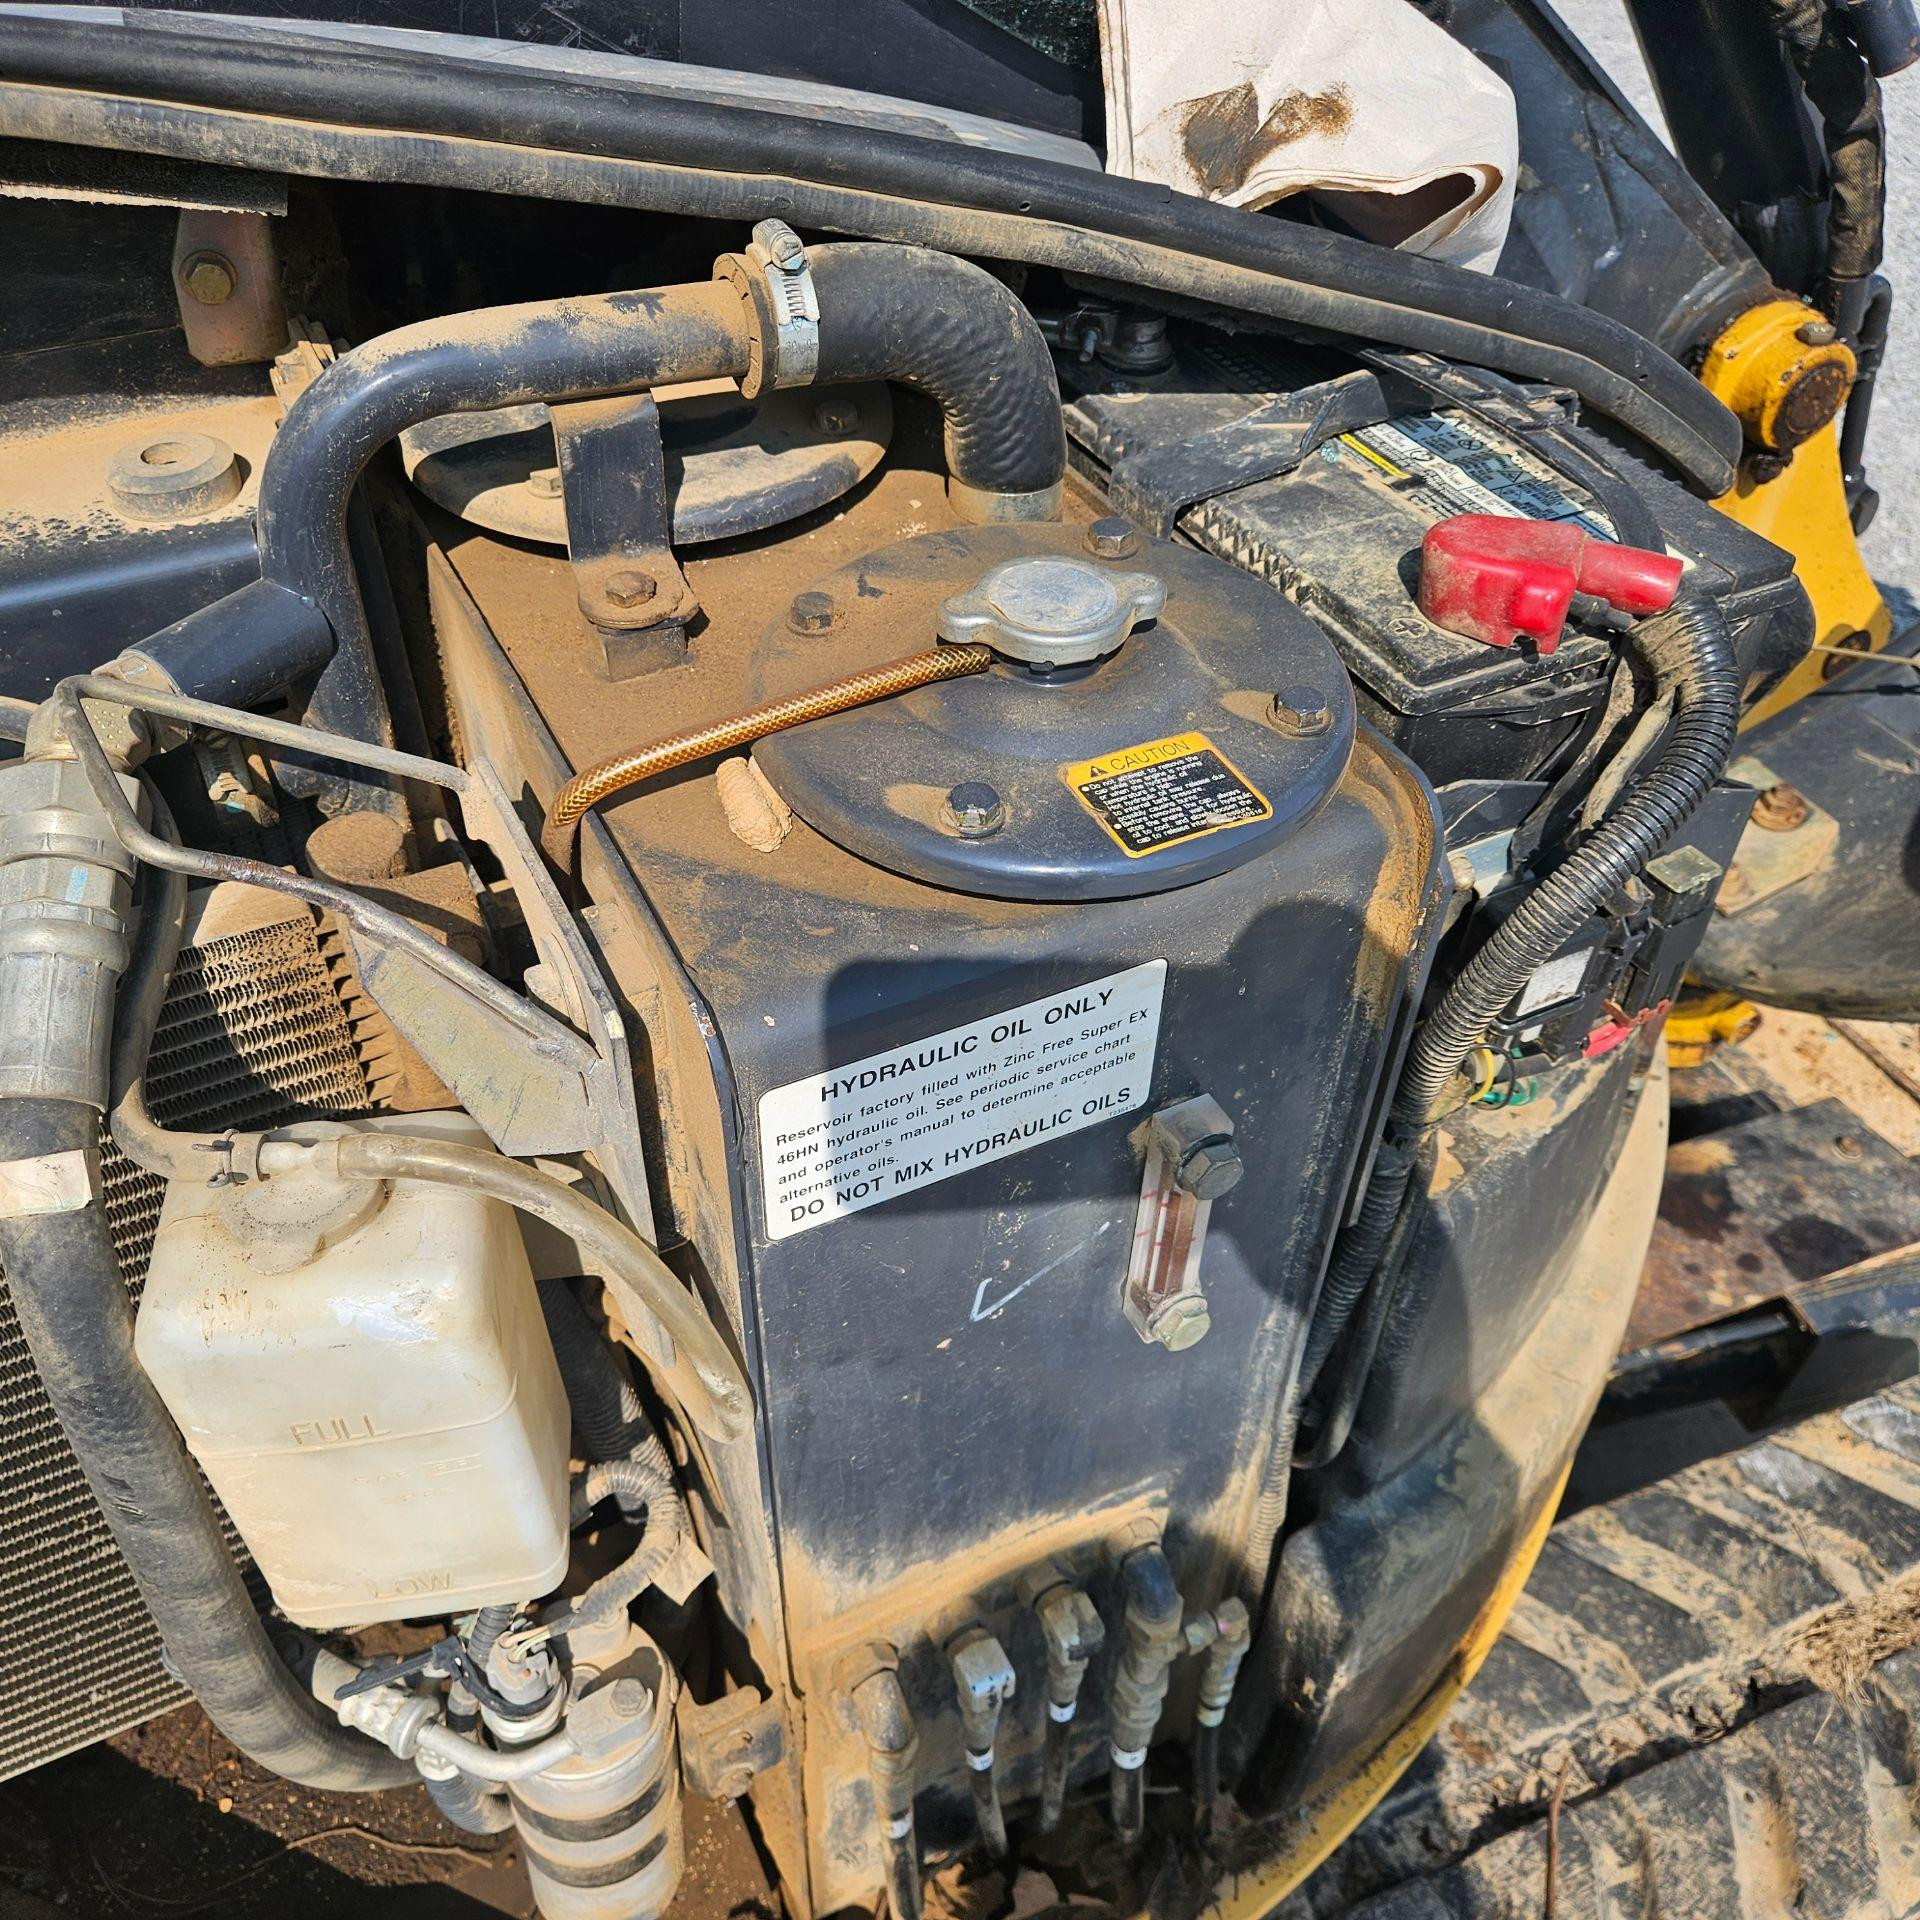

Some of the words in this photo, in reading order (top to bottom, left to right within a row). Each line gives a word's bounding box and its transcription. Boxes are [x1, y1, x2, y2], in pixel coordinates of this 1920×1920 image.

[1109, 740, 1190, 770] CAUTION
[776, 1112, 853, 1146] Reservoir
[860, 1092, 914, 1117] factory
[922, 1075, 958, 1096] filled
[966, 1063, 996, 1080] with
[1004, 1051, 1035, 1068] Zinc
[1043, 1037, 1074, 1054] Free
[1081, 1020, 1122, 1040] Super
[1129, 1008, 1148, 1023] EX
[777, 1143, 818, 1164] 46HN
[827, 1117, 898, 1148] hydraulic
[906, 1106, 928, 1120] oil.
[936, 1095, 963, 1110] See
[970, 1071, 1029, 1101] periodic
[1037, 1051, 1088, 1075] service
[1095, 1034, 1130, 1054] chart
[822, 1036, 978, 1102] HYDRAULIC
[991, 1019, 1032, 1043] OIL
[1045, 988, 1113, 1024] ONLY
[779, 1166, 806, 1185] and
[815, 1138, 892, 1171] operator's
[900, 1114, 954, 1142] manual
[961, 1109, 975, 1120] to
[982, 1082, 1054, 1112] determine
[1061, 1052, 1136, 1085] acceptable
[791, 1199, 824, 1222] DO
[837, 1176, 884, 1205] NOT
[895, 1158, 933, 1184] MIX
[945, 1109, 1072, 1166] HYDRAULIC
[1082, 1088, 1130, 1115] OILS
[780, 1169, 861, 1203] alternative
[868, 1157, 899, 1171] oils.
[290, 1414, 391, 1445] FULL
[365, 1572, 452, 1599] LOW
